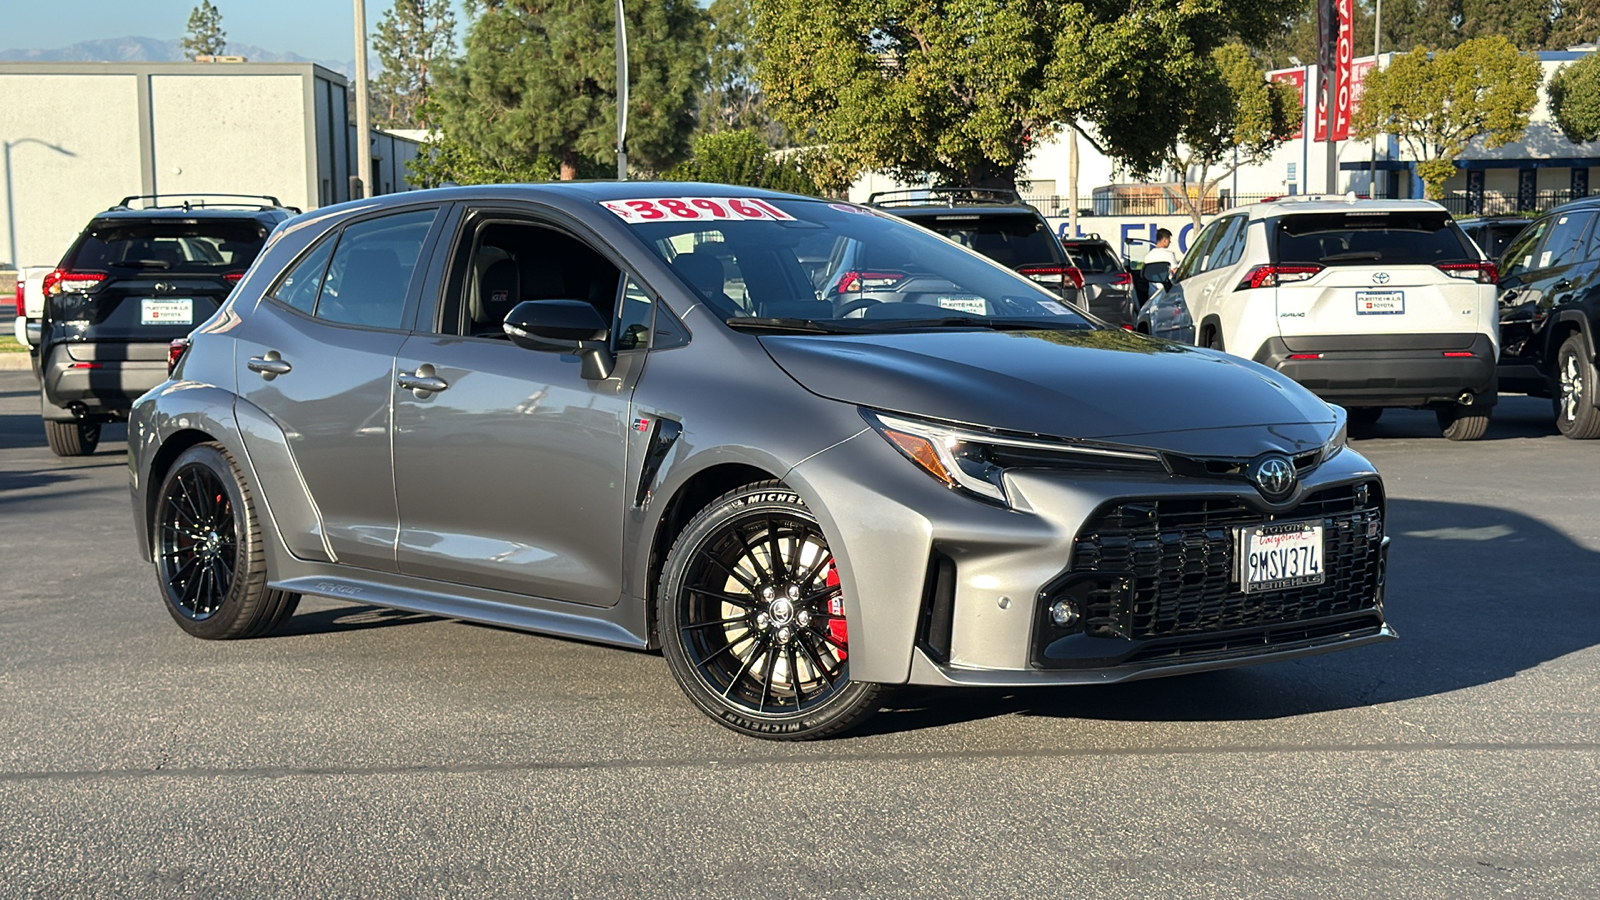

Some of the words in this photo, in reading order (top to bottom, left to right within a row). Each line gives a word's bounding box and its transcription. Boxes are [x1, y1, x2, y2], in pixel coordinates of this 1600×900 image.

[1336, 0, 1350, 132] TOYOTA
[605, 198, 792, 221] $38961
[1264, 522, 1304, 534] TOYOTA
[1249, 546, 1318, 581] 9MSV374
[1291, 575, 1320, 586] HILLS
[724, 712, 800, 734] MICHELIN
